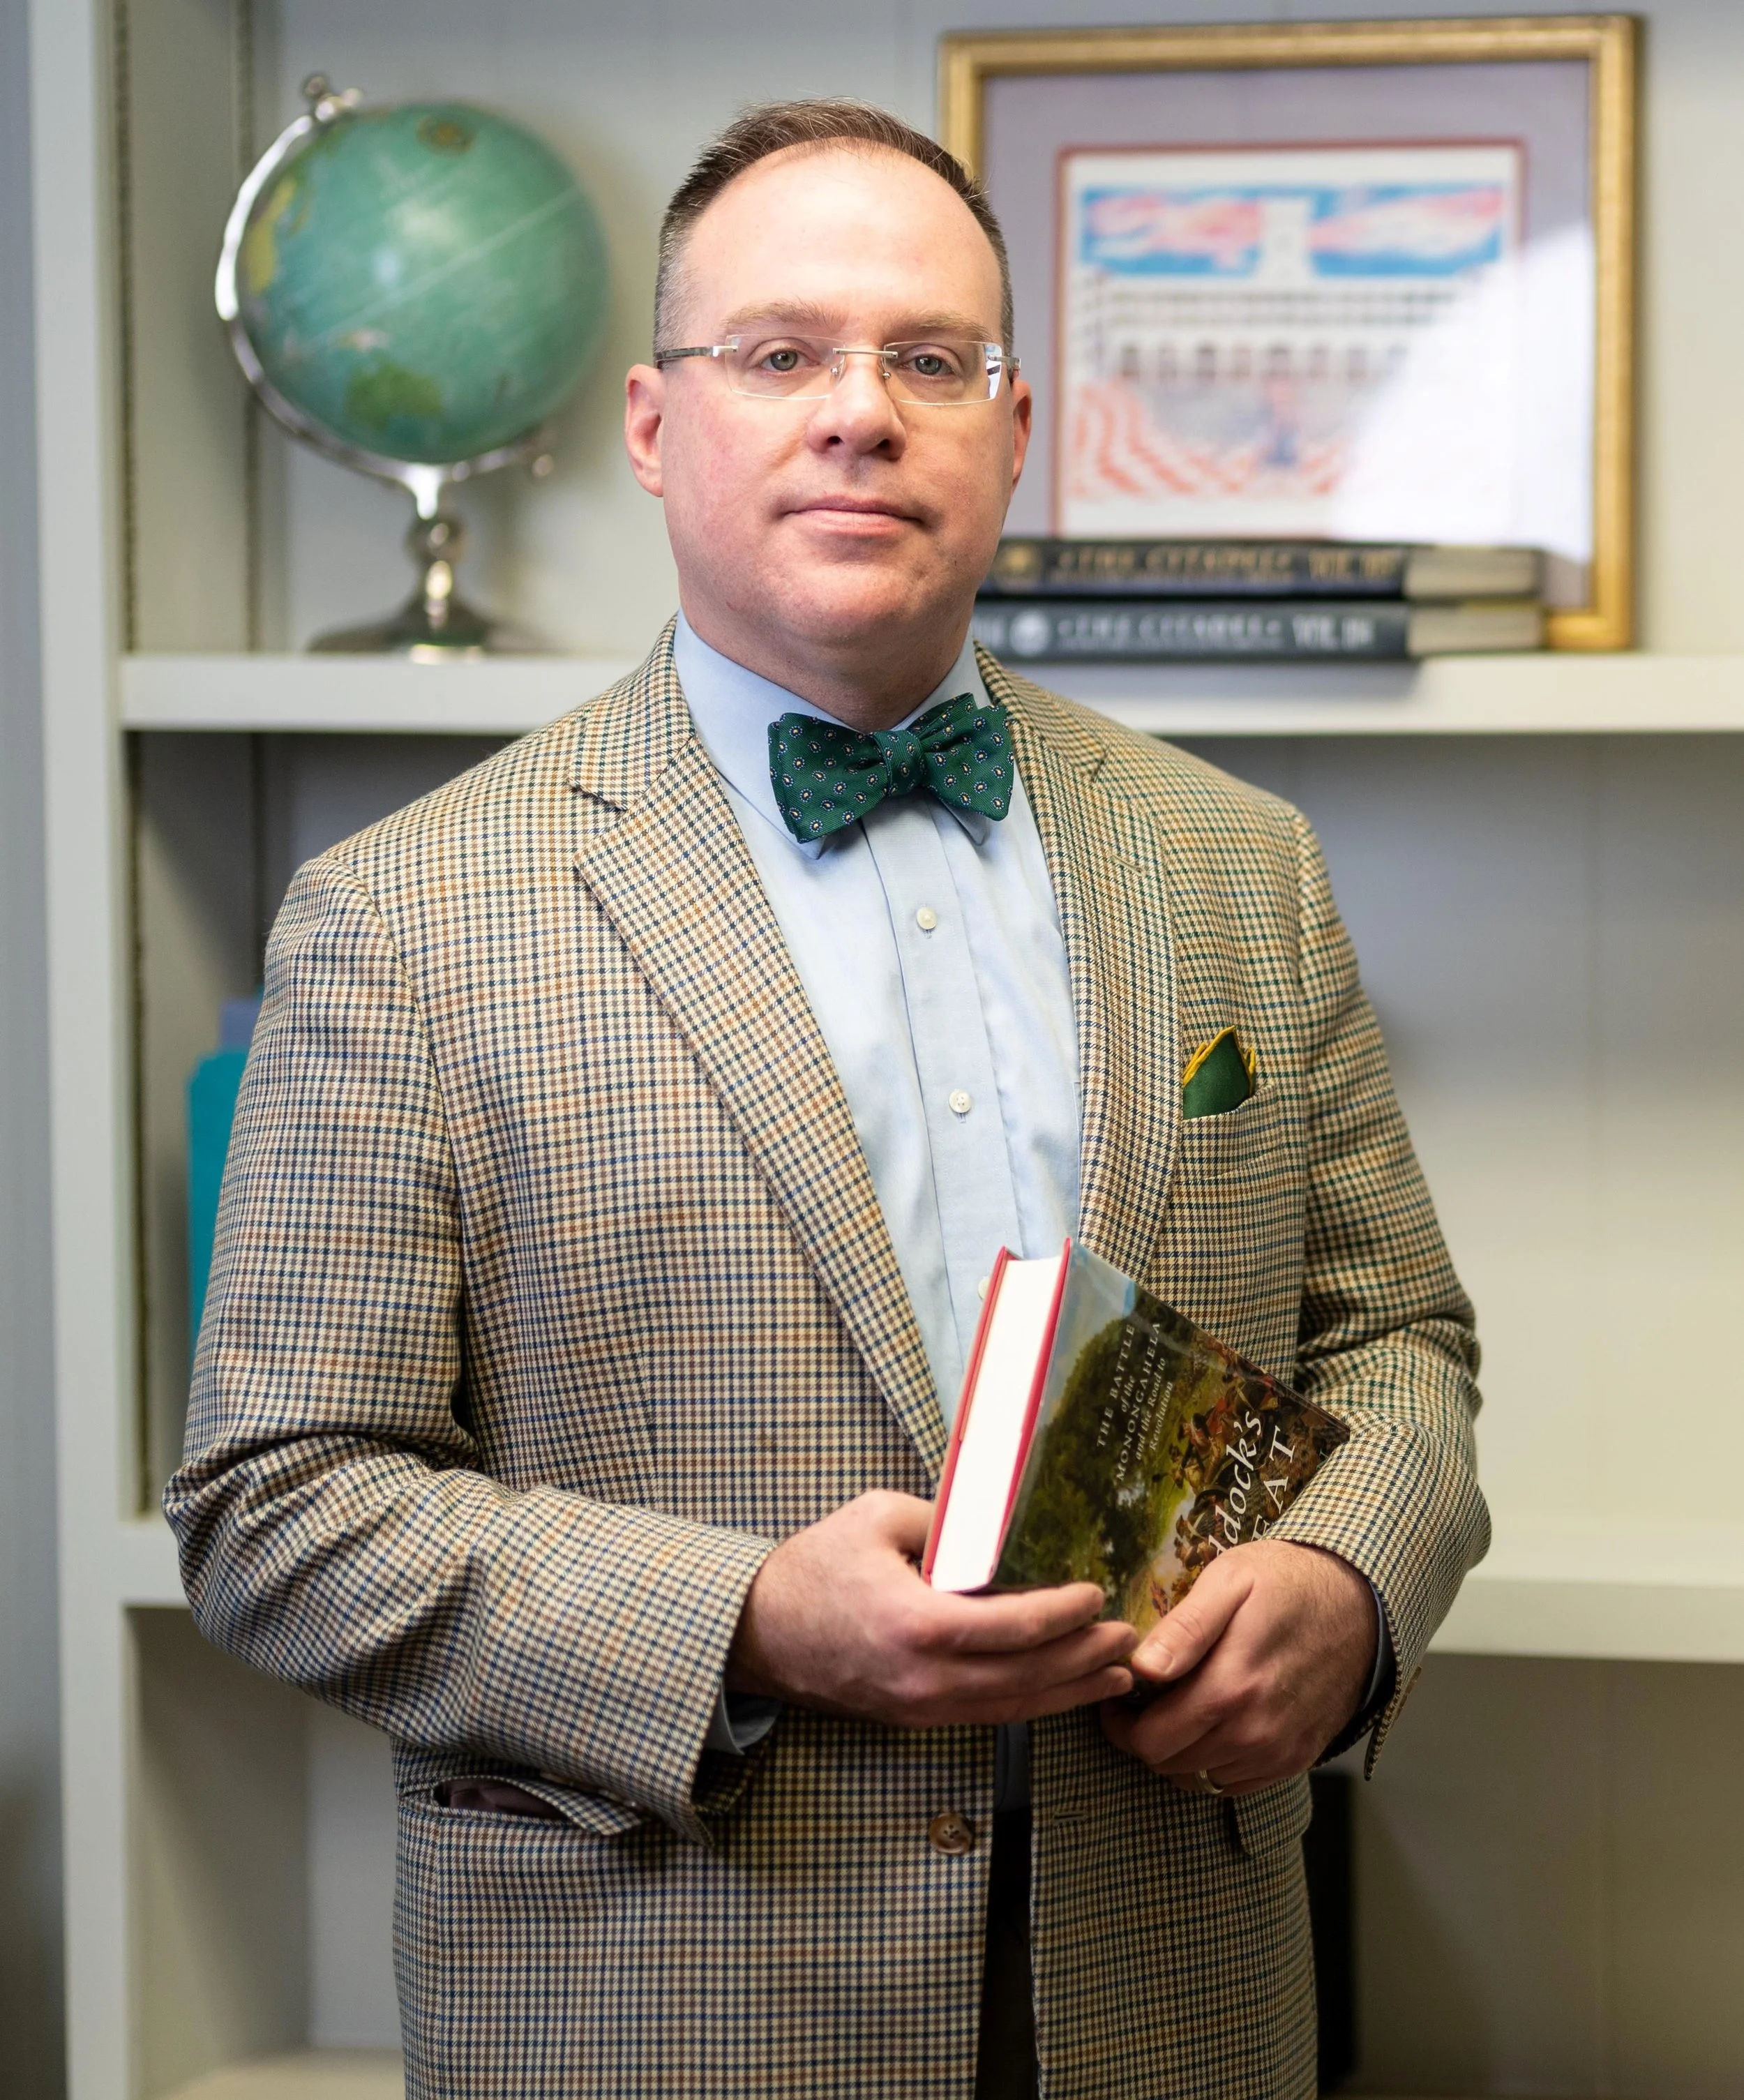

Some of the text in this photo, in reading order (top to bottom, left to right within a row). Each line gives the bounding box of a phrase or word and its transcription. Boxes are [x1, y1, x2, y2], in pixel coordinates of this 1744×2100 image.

[1097, 1324, 1135, 1448] THE BATTLE
[1116, 1323, 1160, 1481] MONONGAHELA
[1121, 1375, 1136, 1413] of the
[1135, 1358, 1166, 1460] and the Road to
[1149, 1381, 1173, 1451] Revolution
